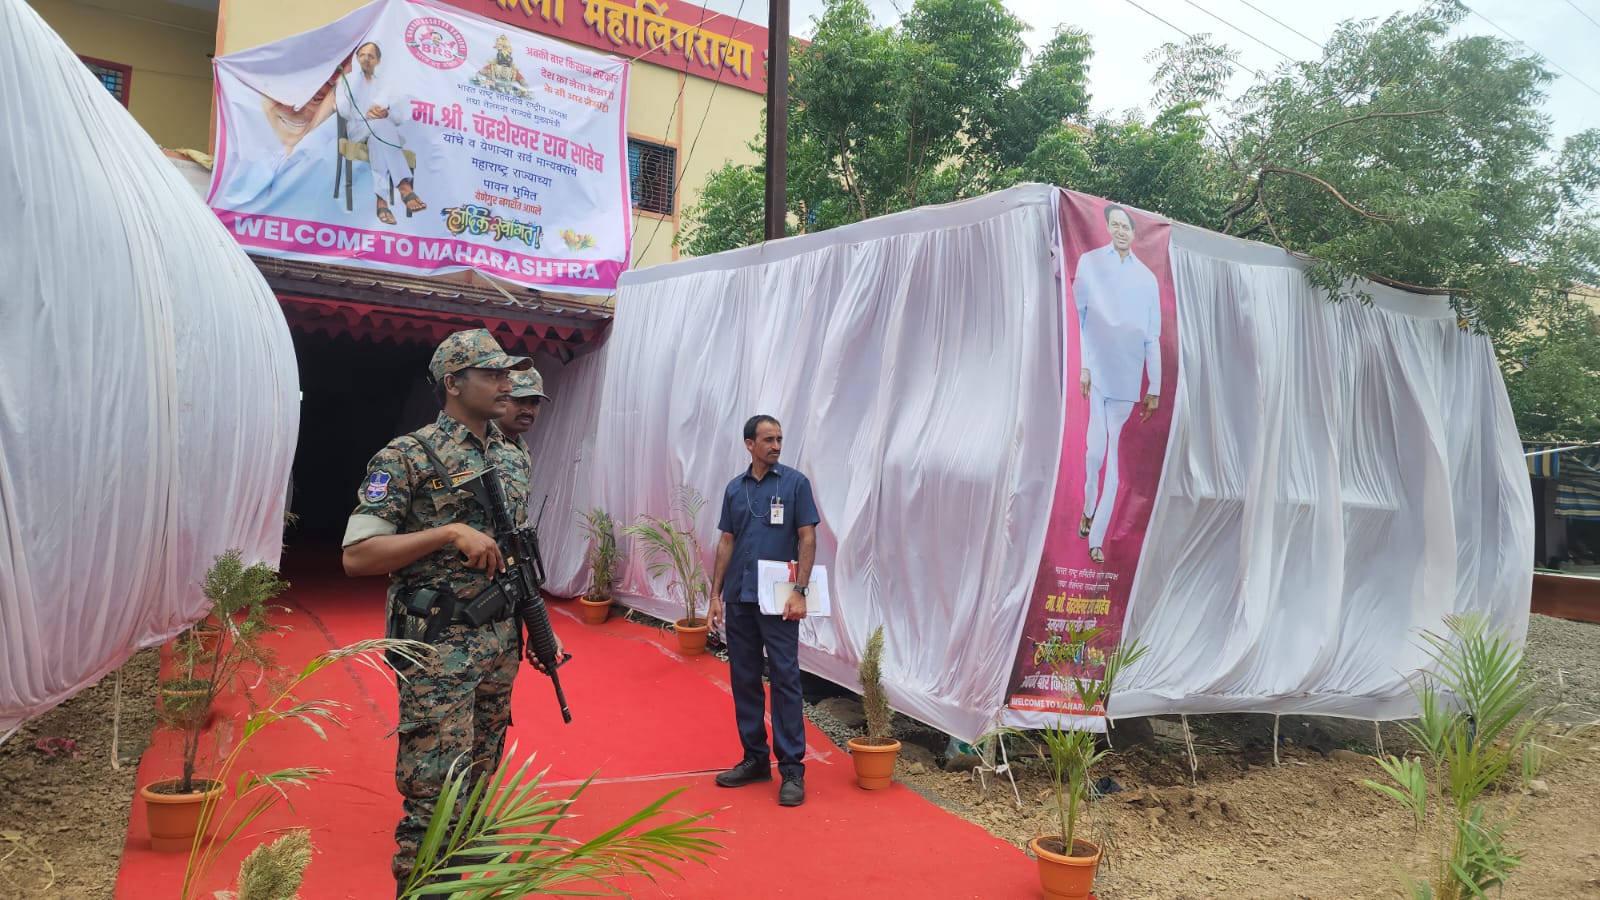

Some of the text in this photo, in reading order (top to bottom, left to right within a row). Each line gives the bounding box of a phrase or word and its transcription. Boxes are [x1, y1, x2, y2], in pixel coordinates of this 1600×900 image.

[421, 43, 453, 59] BRS
[443, 132, 464, 146] यांचे
[468, 139, 476, 149] व
[517, 151, 533, 163] सर्व
[472, 110, 541, 151] चंद्रशेखर
[542, 132, 570, 160] राव
[570, 141, 605, 173] साहेब
[472, 156, 509, 176] महाराष्ट्र
[483, 179, 509, 193] पावन
[234, 216, 600, 280] WELCOME TO MAHARASHTRA
[1012, 697, 1045, 708] WELCOME
[1046, 700, 1056, 708] TO
